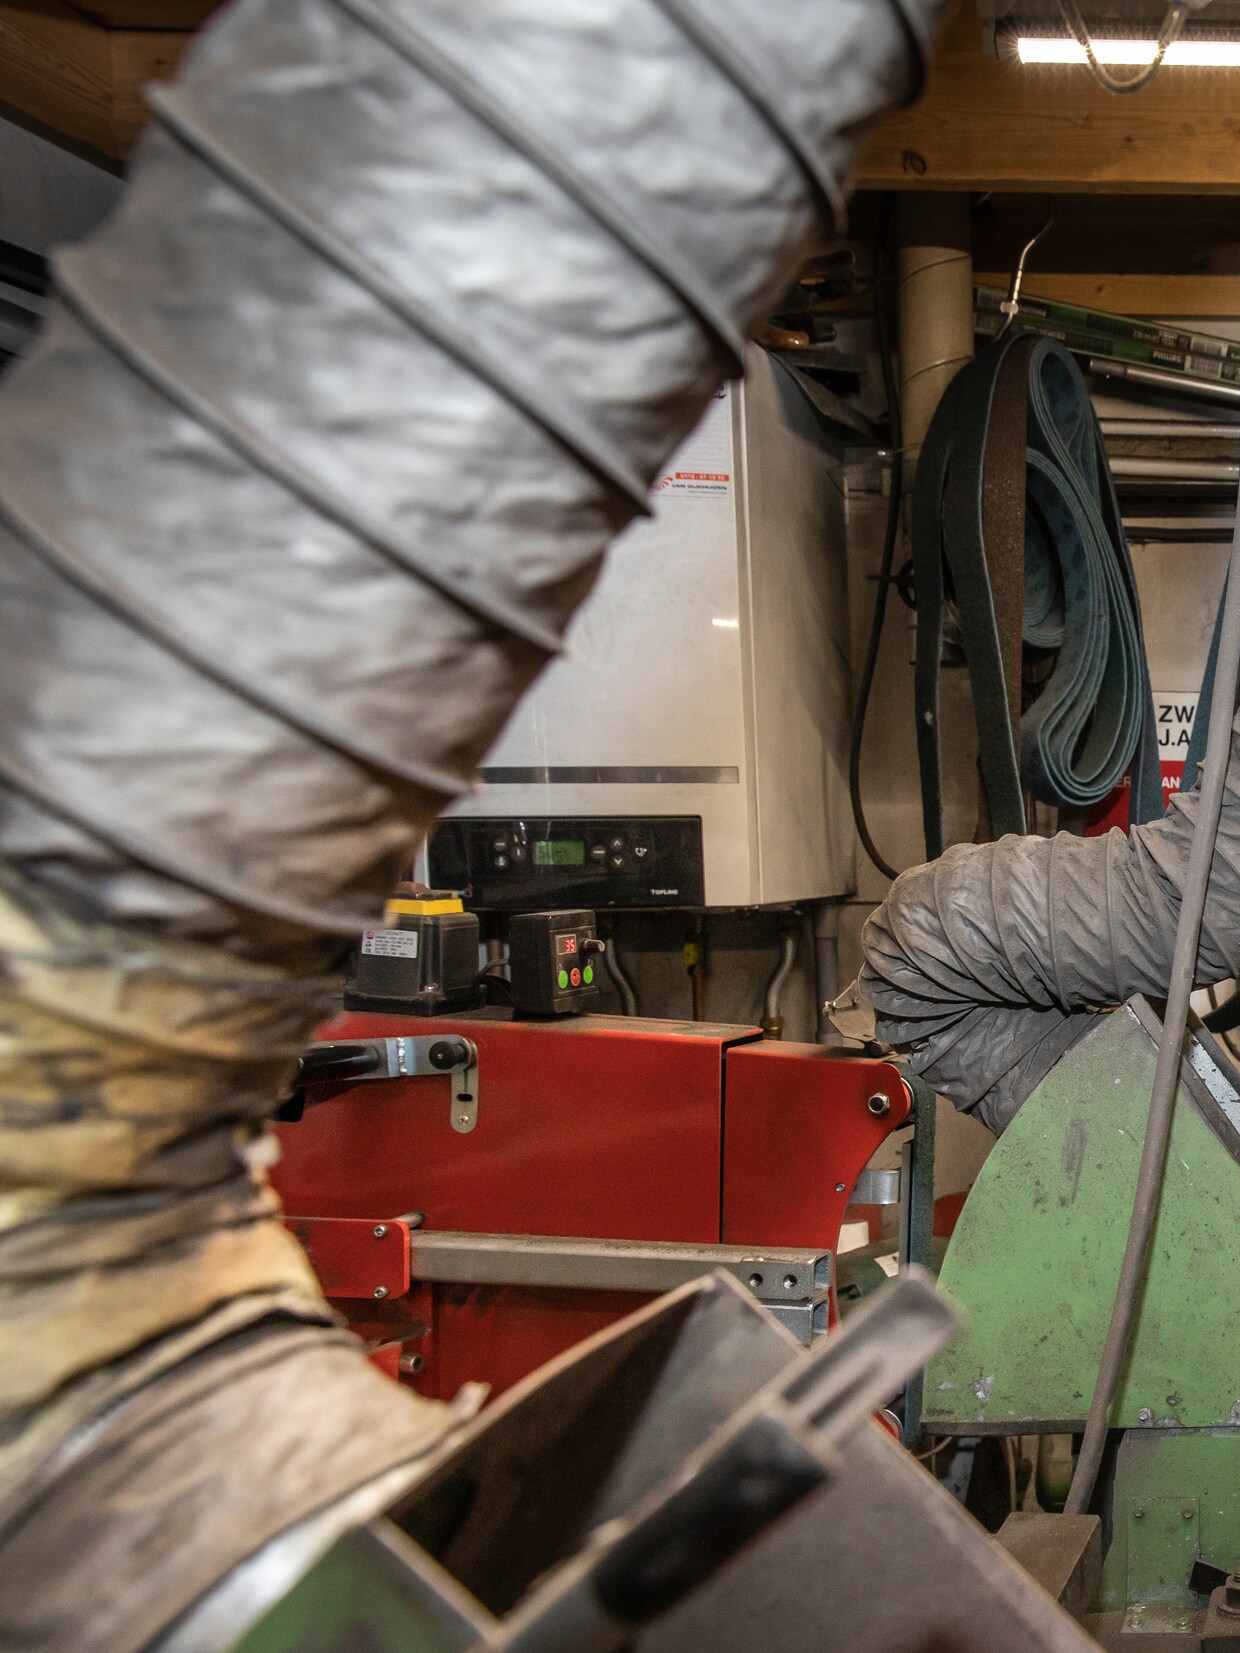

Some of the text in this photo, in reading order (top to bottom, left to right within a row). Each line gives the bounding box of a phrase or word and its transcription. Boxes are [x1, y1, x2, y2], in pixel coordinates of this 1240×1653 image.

[1152, 350, 1182, 363] PHILIPS
[650, 888, 679, 896] TOPLINE
[565, 939, 575, 952] 35
